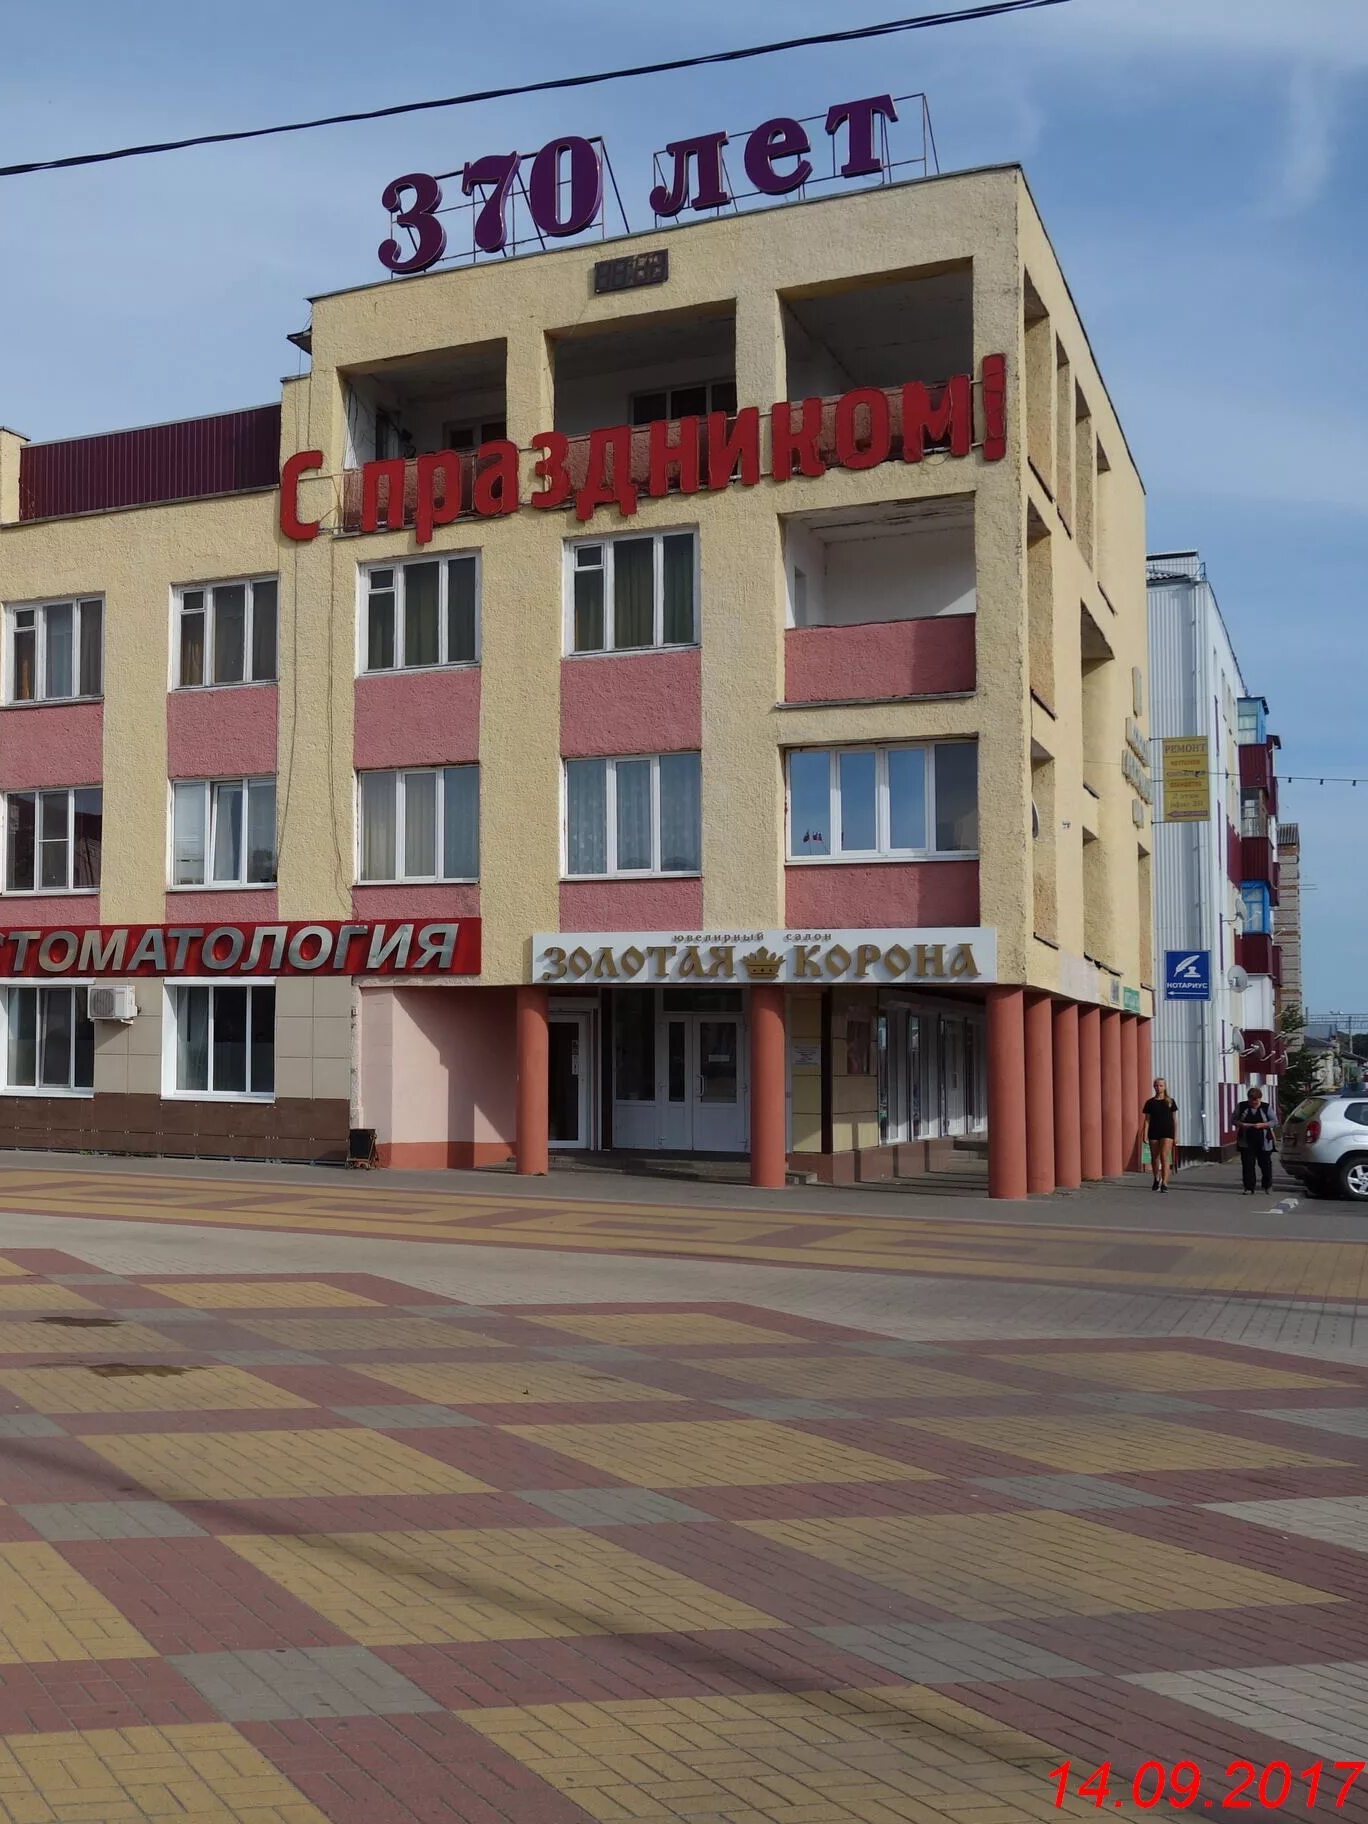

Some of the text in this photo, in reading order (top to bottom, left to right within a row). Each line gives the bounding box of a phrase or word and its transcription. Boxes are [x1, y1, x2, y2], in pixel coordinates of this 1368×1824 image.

[378, 94, 898, 273] 370 лет
[281, 353, 1007, 544] С праздником!
[1165, 743, 1206, 753] РЕМОНТ
[673, 932, 832, 943] ювелирный салон
[542, 943, 982, 980] ЗОЛОТАЯ КОРОНА
